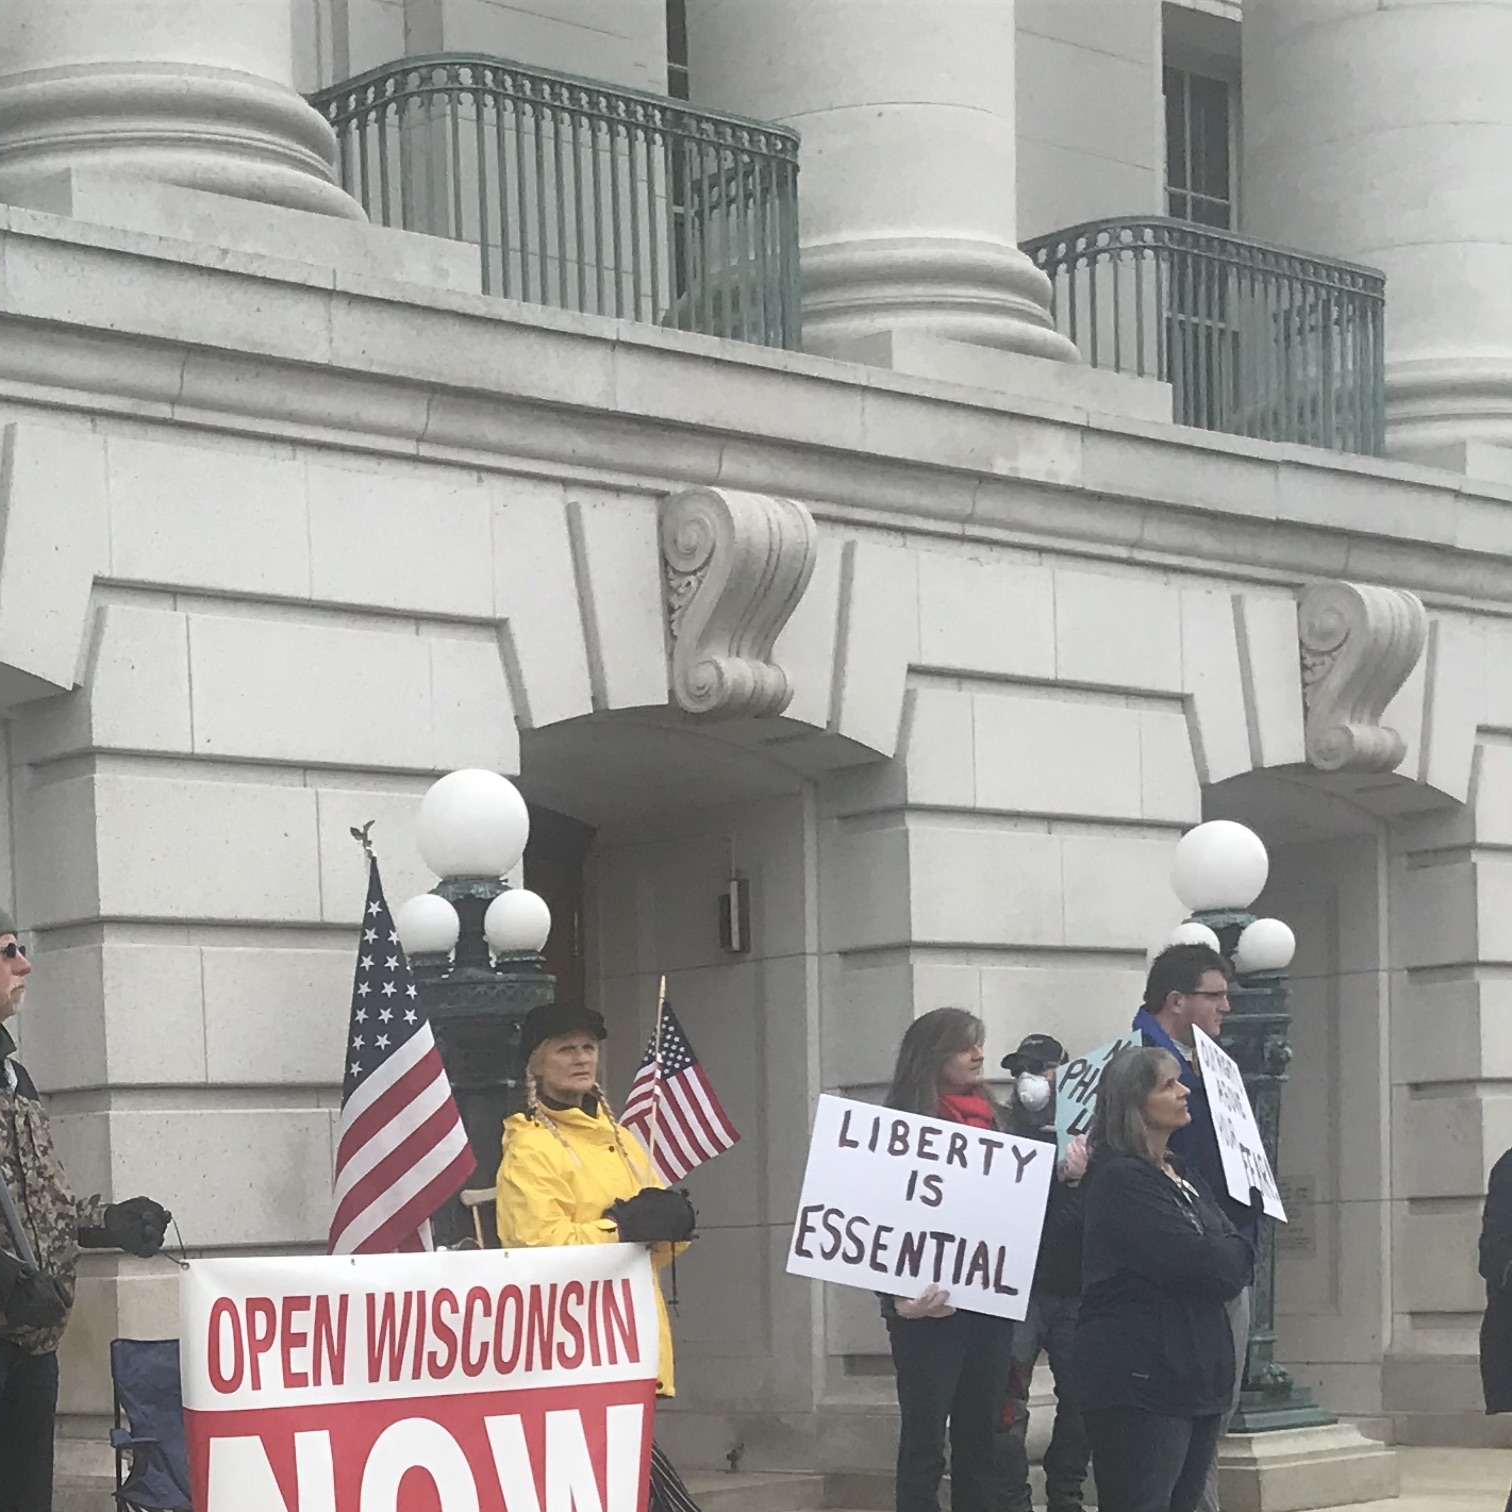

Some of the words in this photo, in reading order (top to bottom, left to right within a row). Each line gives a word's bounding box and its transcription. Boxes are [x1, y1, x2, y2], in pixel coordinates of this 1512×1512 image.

[838, 1109, 1037, 1183] LIBERTY
[906, 1170, 944, 1207] IS
[794, 1204, 1019, 1296] ESSENTIAL
[207, 1294, 349, 1394] OPEN
[366, 1277, 641, 1383] WISCONSIN
